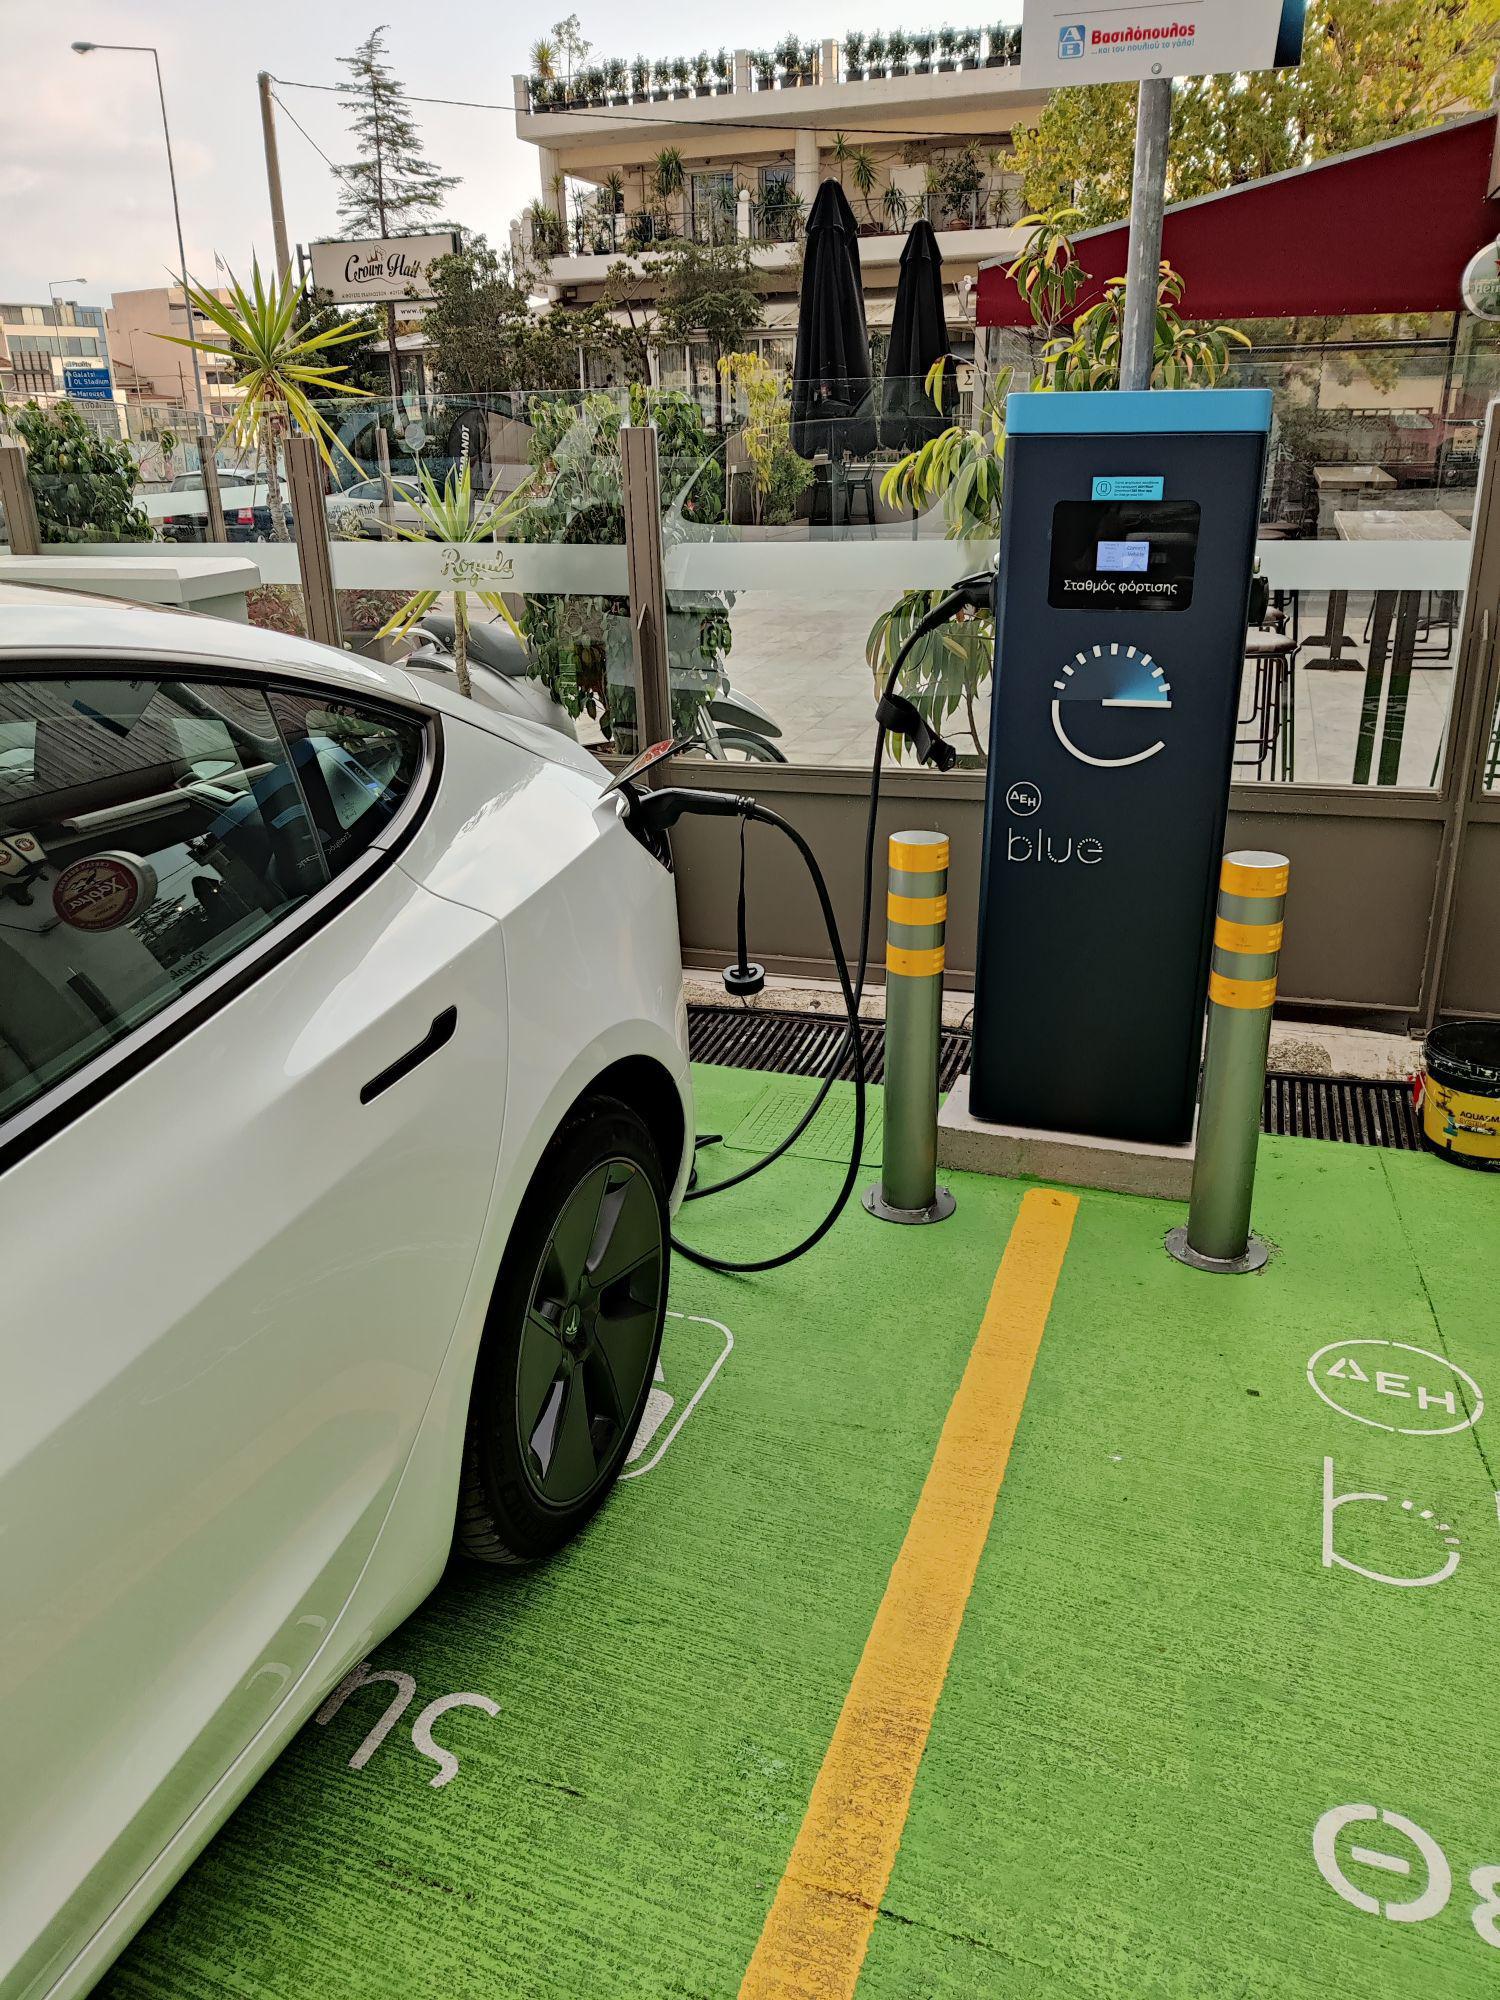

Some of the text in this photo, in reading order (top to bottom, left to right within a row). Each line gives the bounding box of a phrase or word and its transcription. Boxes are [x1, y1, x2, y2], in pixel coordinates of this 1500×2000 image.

[1091, 22, 1196, 45] Βασιλόπουλος
[1112, 45, 1125, 54] του
[1127, 40, 1160, 52] πουλιού
[1173, 38, 1195, 49] γάλα!
[344, 254, 384, 283] Crown
[440, 548, 514, 587] Royals
[1064, 580, 1178, 595] Σταθμός φόρτισης
[1010, 790, 1036, 807] ΔΕΗ
[1007, 828, 1103, 864] blue
[1326, 1357, 1456, 1415] ΔΕΗ
